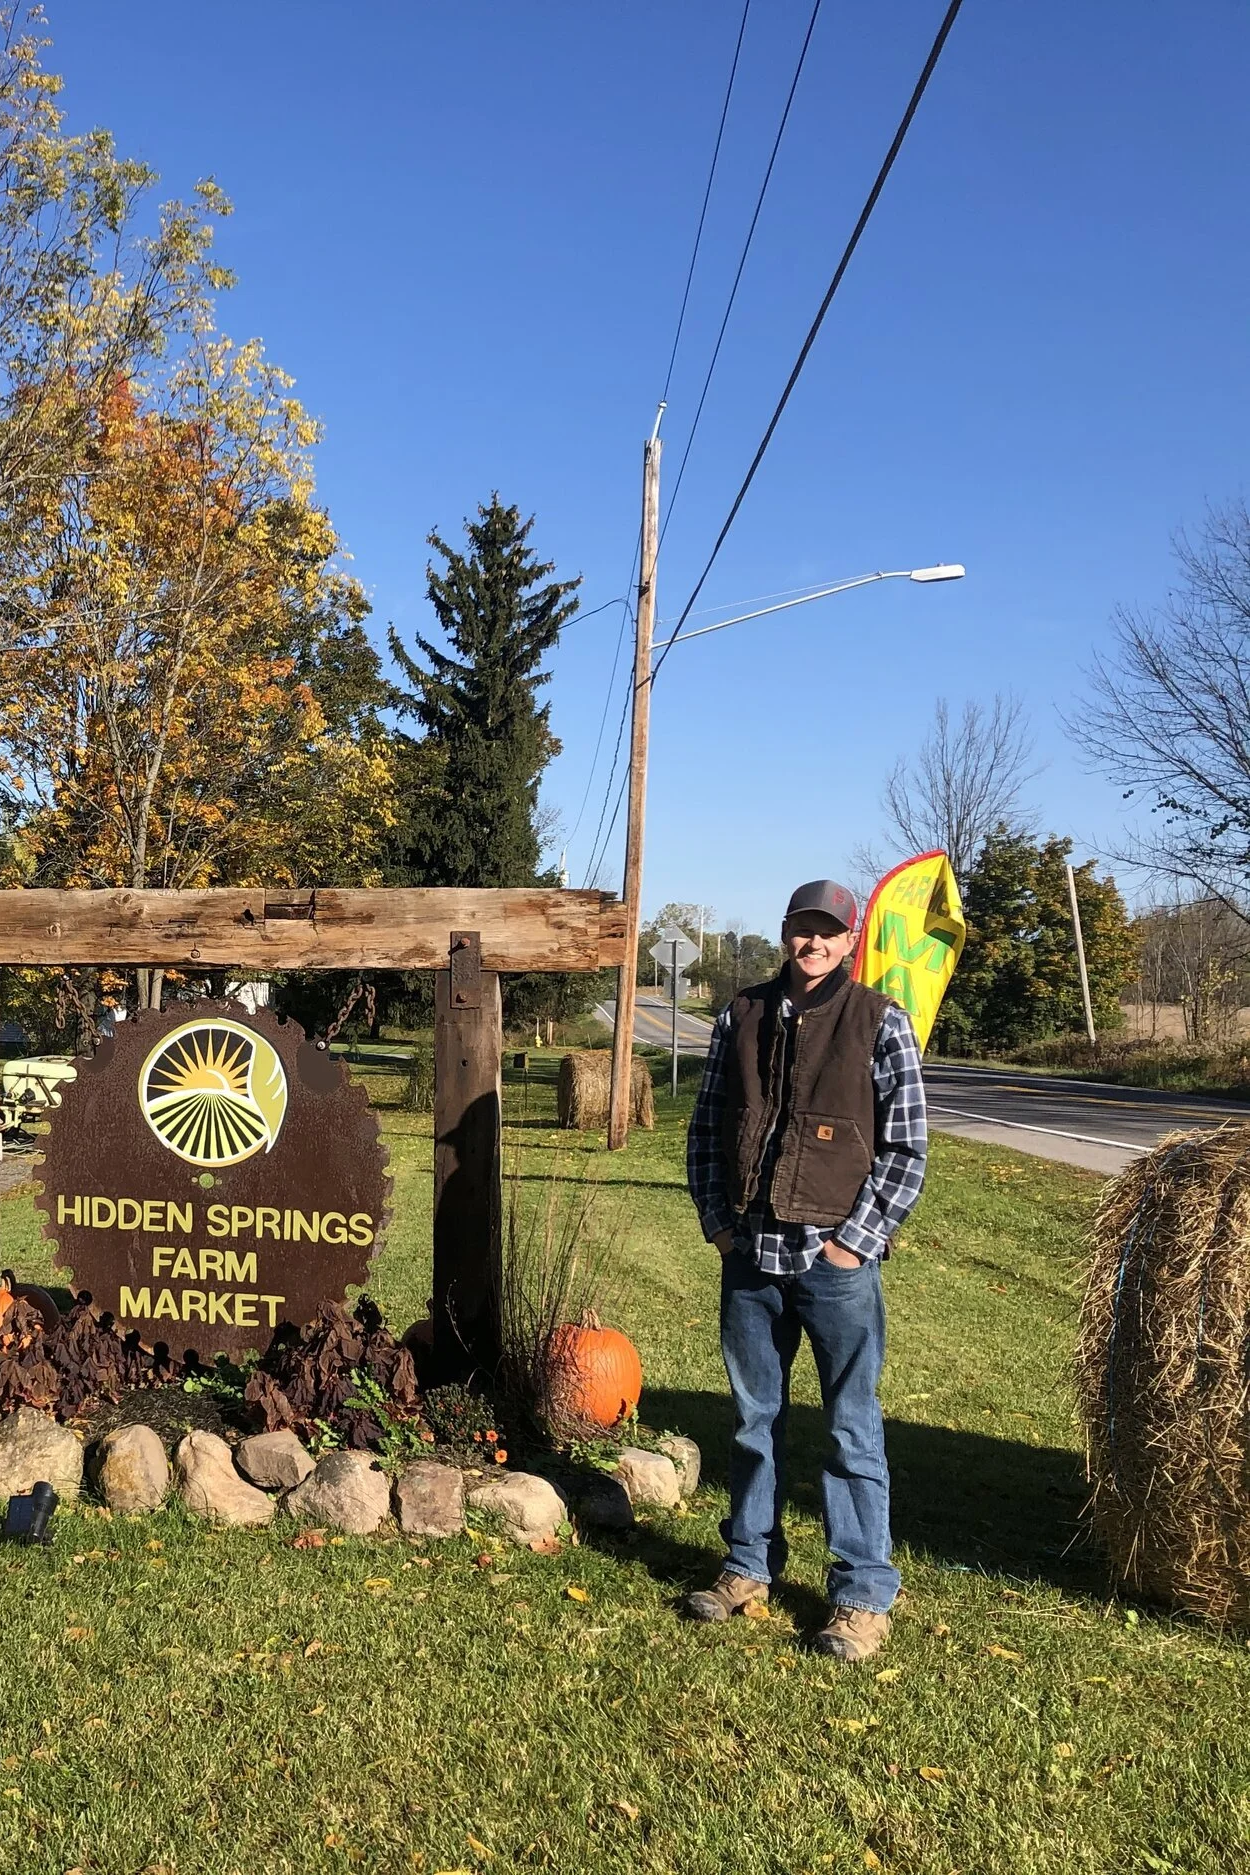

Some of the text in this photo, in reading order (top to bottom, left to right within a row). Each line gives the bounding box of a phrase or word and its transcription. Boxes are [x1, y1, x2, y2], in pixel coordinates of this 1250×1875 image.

[57, 1194, 374, 1246] HIDDEN SPRINGS
[152, 1246, 257, 1283] FARM
[119, 1286, 286, 1328] MARKET
